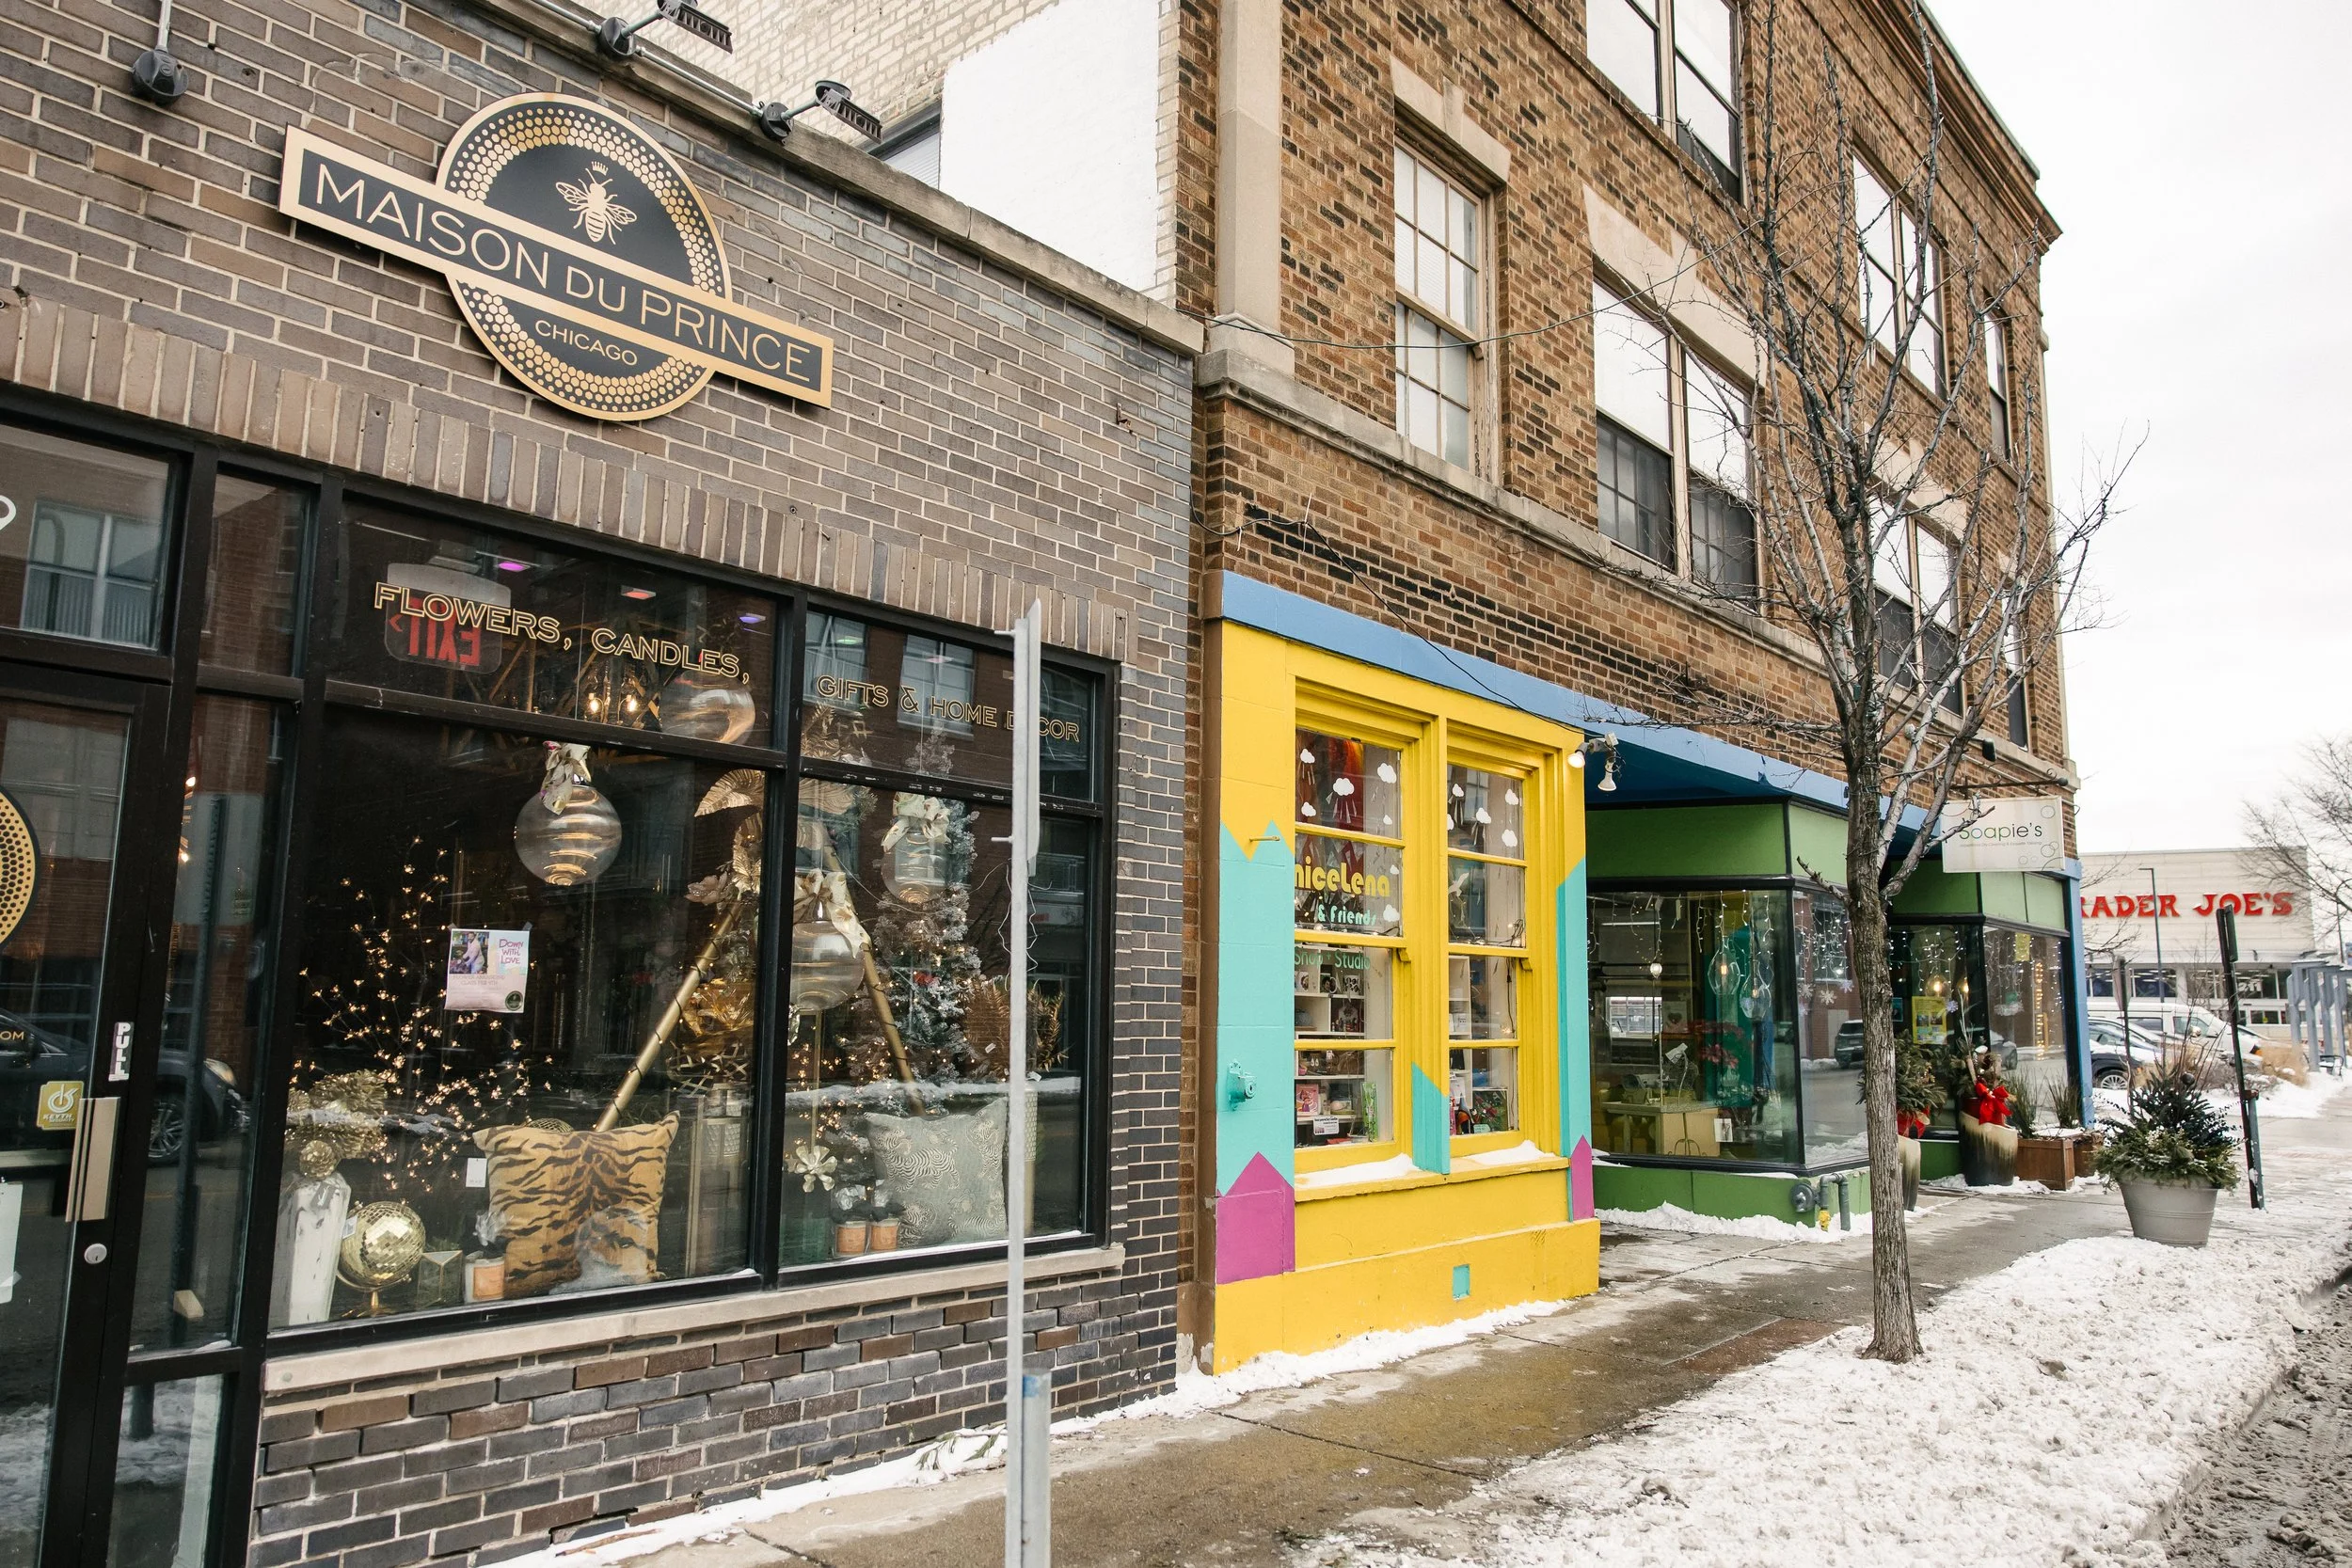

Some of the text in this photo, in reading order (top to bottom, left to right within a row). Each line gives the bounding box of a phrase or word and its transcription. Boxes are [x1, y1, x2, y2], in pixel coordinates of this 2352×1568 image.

[317, 164, 811, 383] MAISON DU PRINCE
[534, 319, 638, 367] CHICAGO
[373, 581, 1080, 743] FLOWERS, CANDLES, GIFTS & HOME DCOR
[1960, 822, 2042, 842] Soapie's
[2192, 892, 2295, 917] JOE'S
[1335, 949, 1371, 971] Studio
[108, 1022, 132, 1082] PULL
